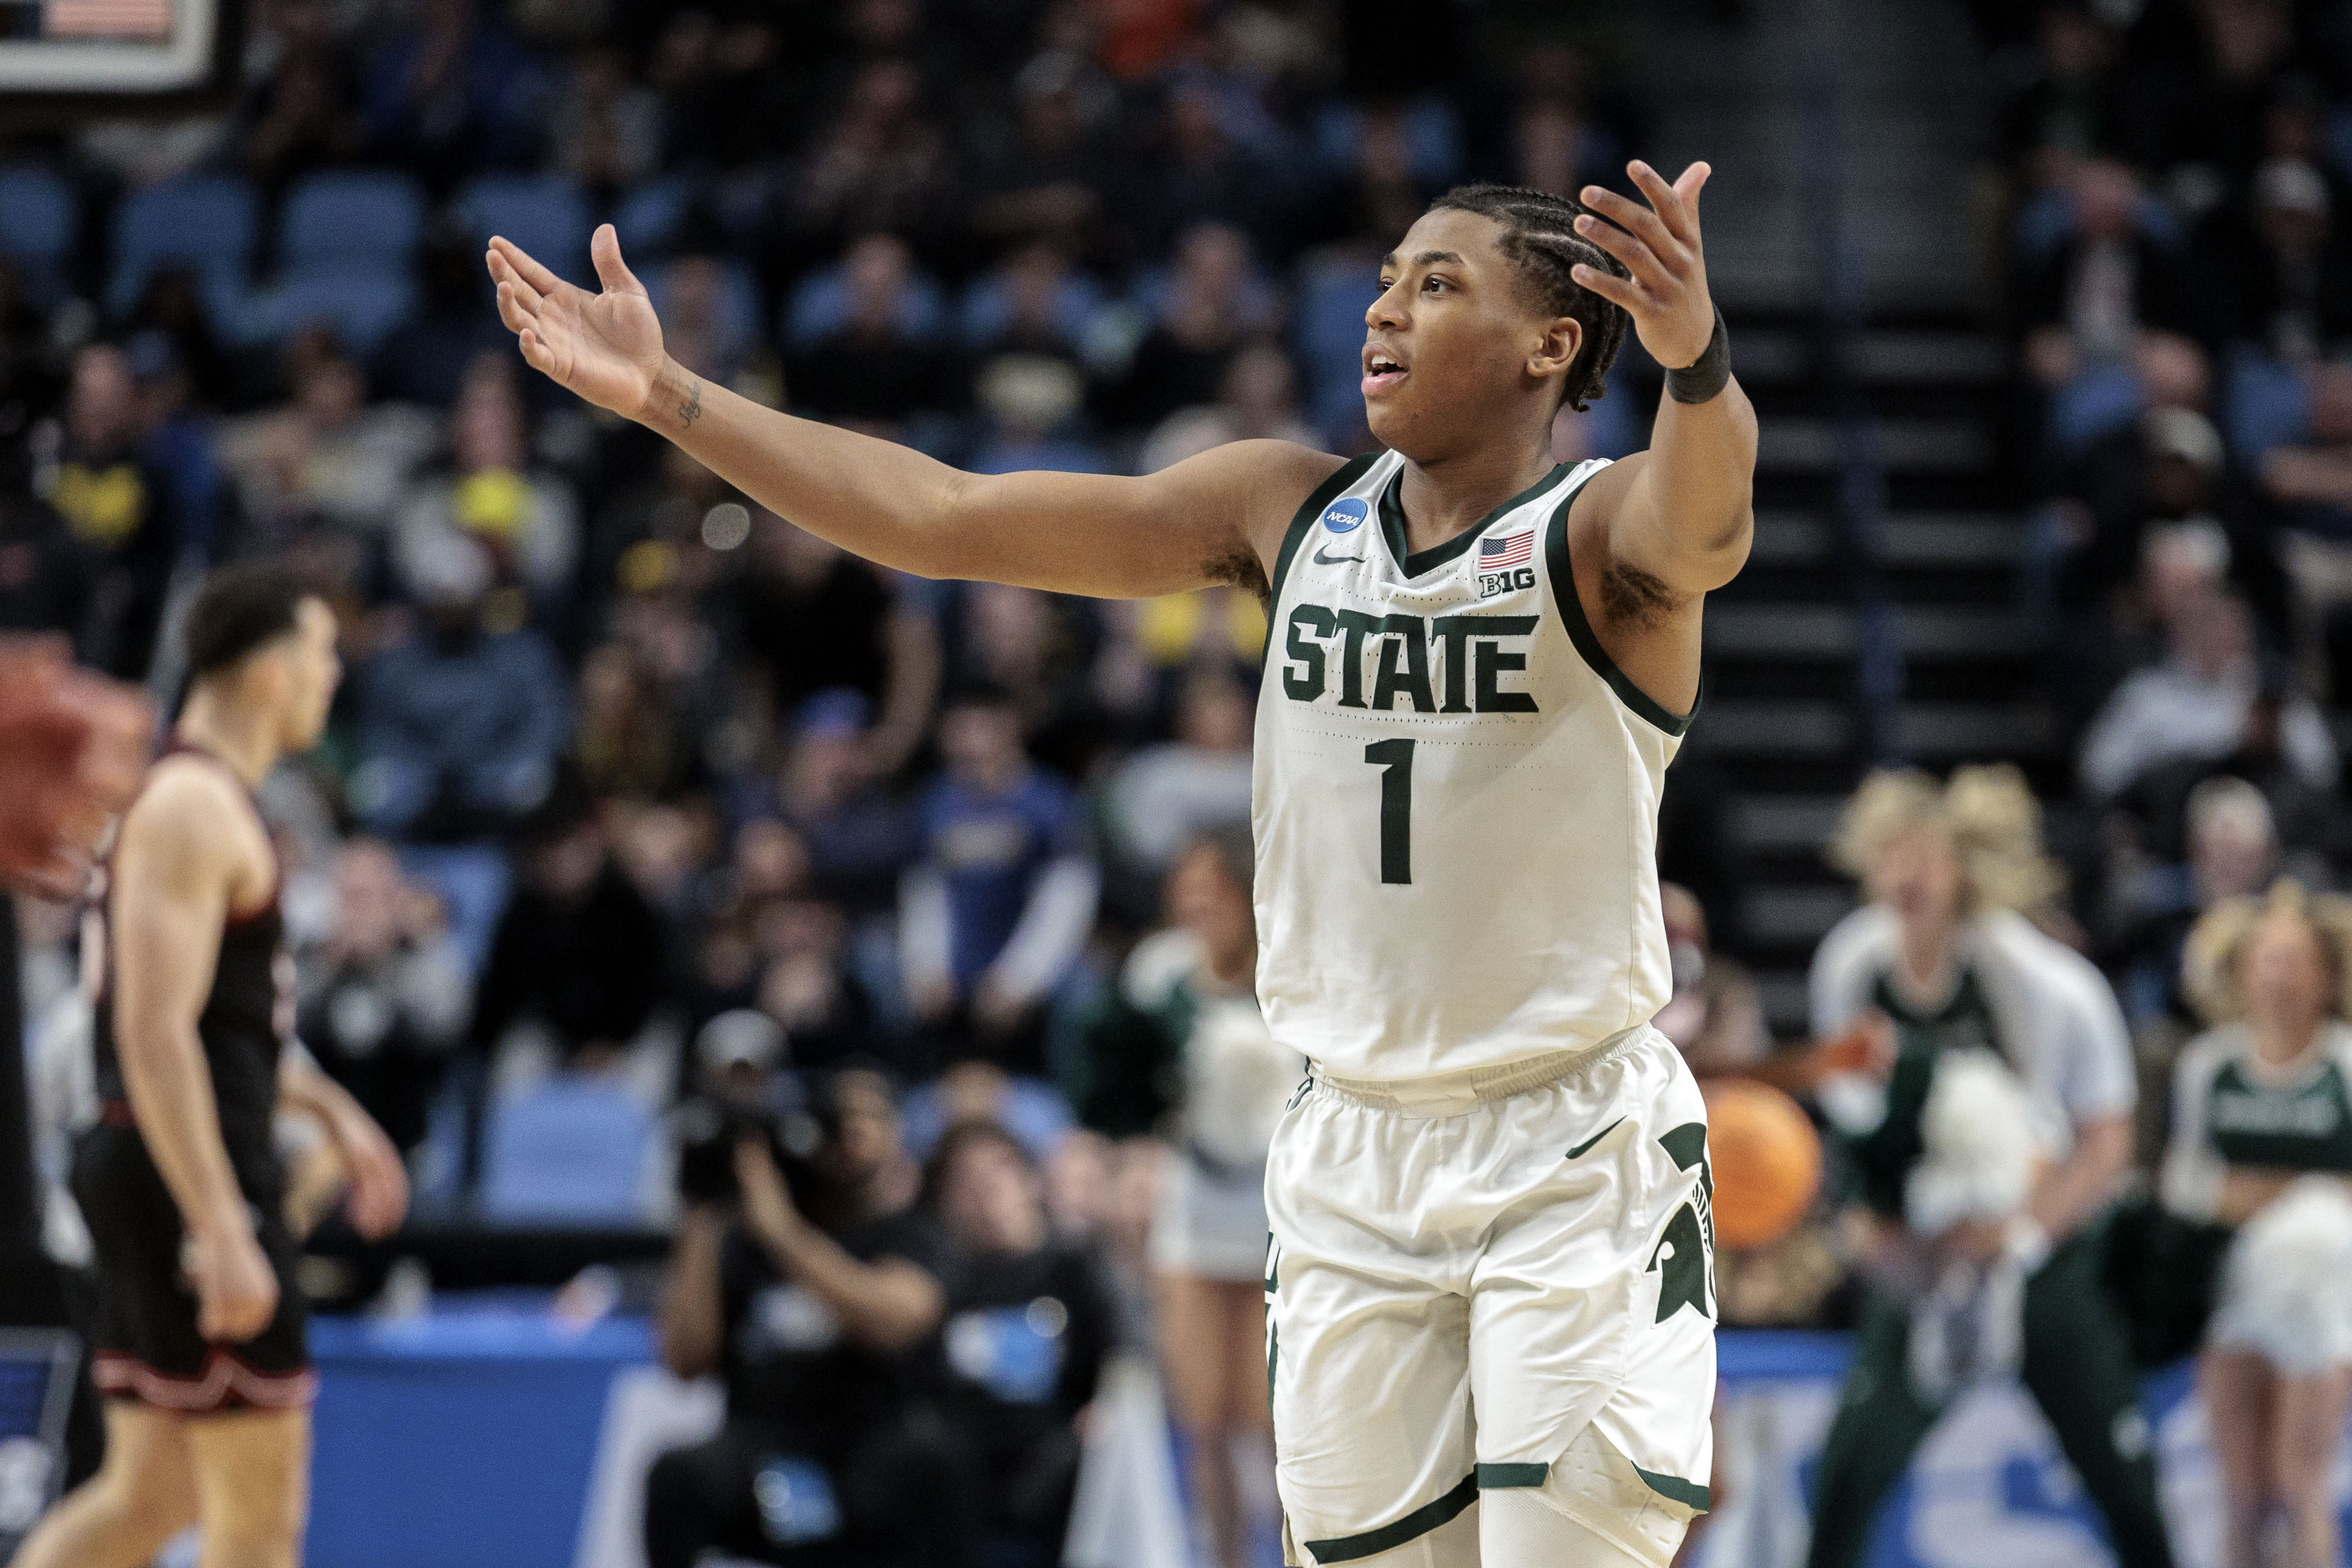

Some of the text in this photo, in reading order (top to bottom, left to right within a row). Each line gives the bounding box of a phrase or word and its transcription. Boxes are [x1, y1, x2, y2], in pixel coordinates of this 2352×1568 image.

[1326, 511, 1359, 525] NCAA
[1283, 604, 1540, 713] STATE
[1364, 739, 1416, 884] 1
